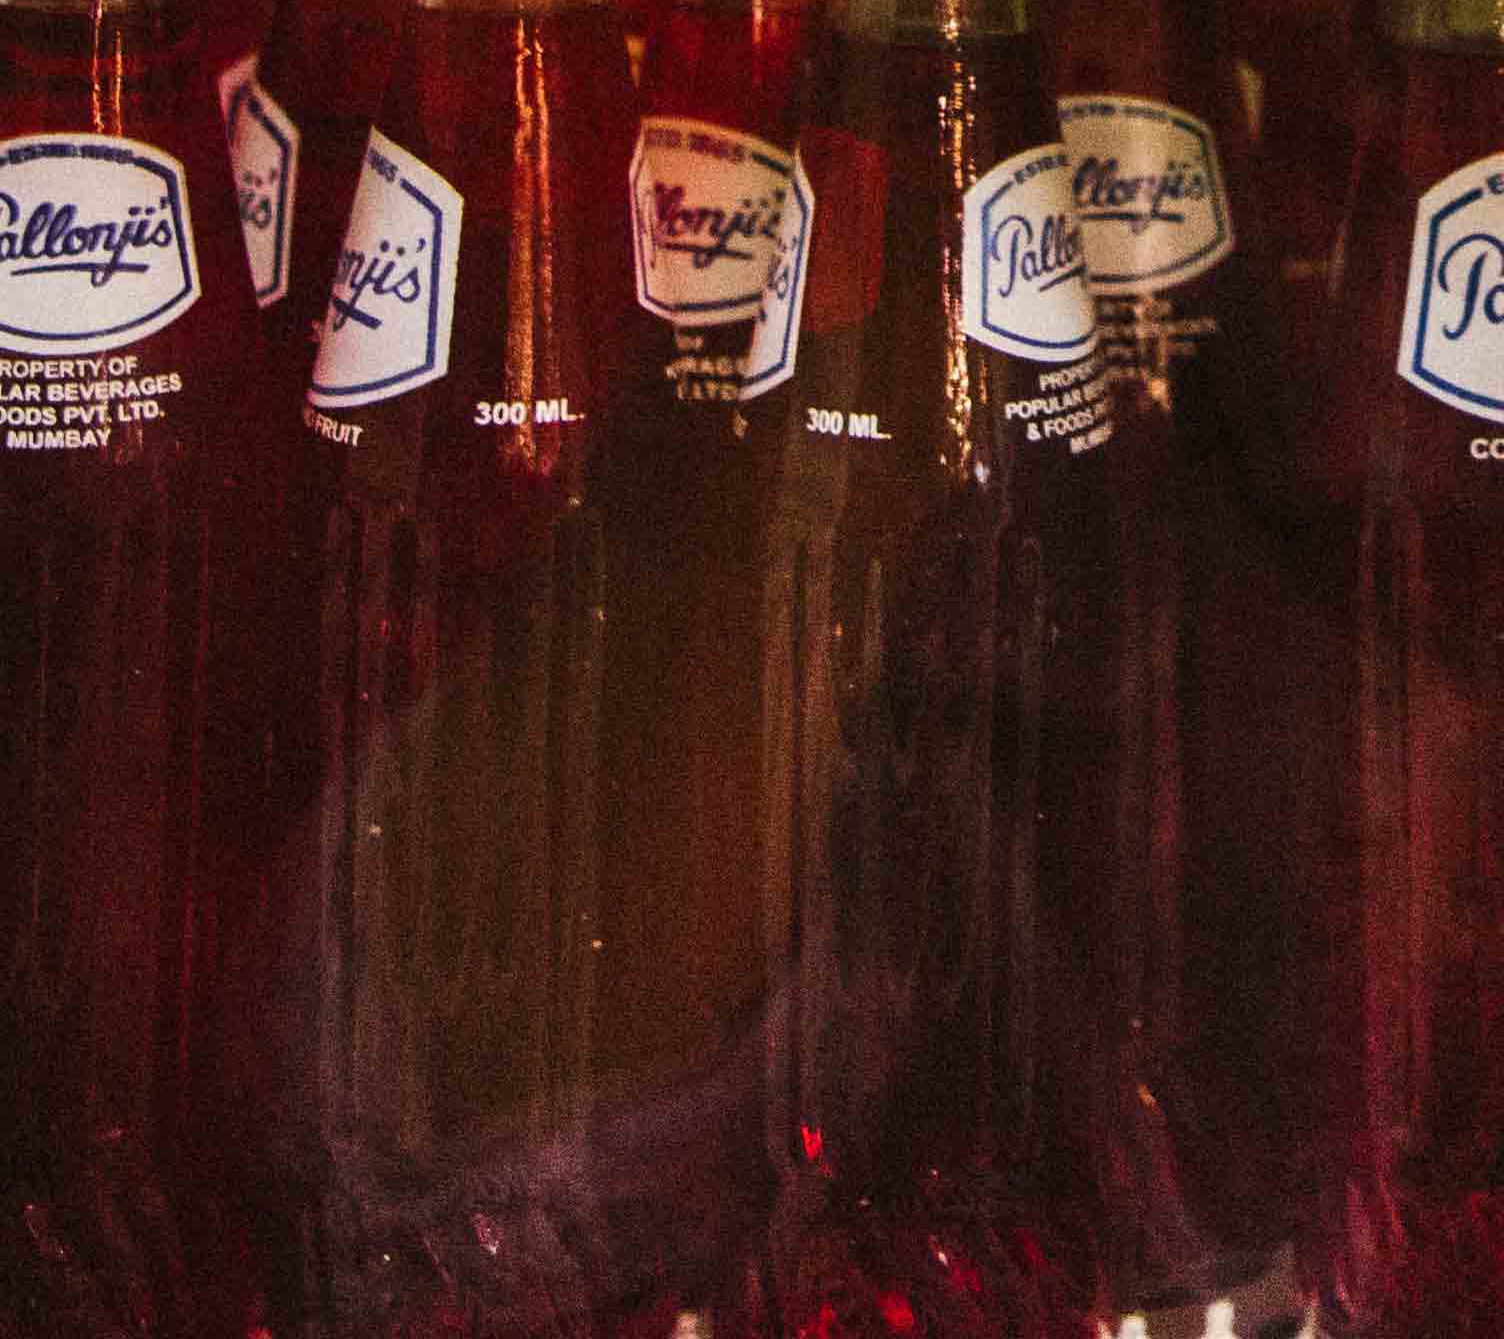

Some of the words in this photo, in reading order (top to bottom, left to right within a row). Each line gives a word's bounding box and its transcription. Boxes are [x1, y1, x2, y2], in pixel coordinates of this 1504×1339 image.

[108, 356, 139, 375] OF
[46, 372, 183, 402] BEVERAGES
[62, 405, 112, 426] PVT.
[118, 400, 166, 422] LTD.
[474, 400, 527, 426] 300
[535, 397, 586, 424] ML.
[806, 407, 844, 437] 300
[848, 412, 893, 441] ML.
[6, 428, 112, 450] MUMBAY
